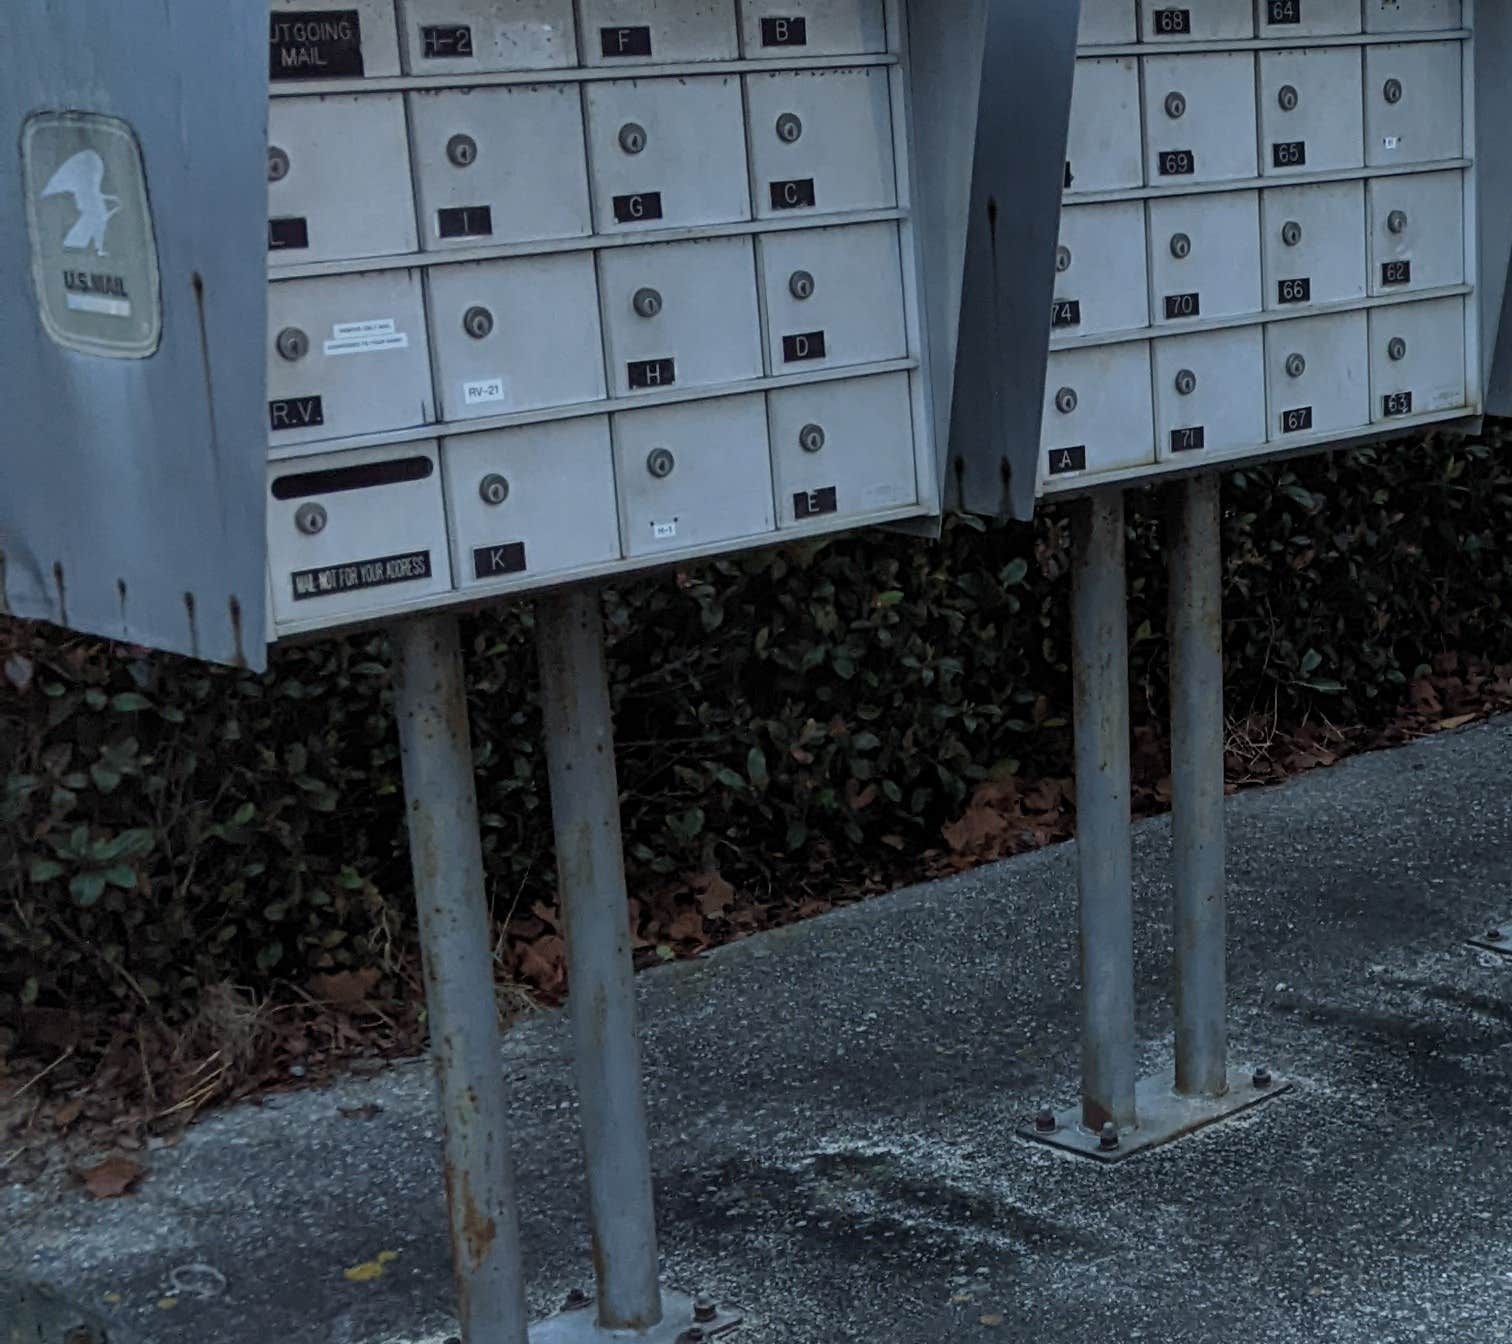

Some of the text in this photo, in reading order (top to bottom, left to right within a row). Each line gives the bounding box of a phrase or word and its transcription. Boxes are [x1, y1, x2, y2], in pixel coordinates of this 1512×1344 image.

[1161, 12, 1183, 31] 68
[1273, 2, 1293, 21] 64
[270, 22, 351, 42] UTGOING
[618, 30, 631, 52] F
[775, 20, 789, 42] B
[280, 46, 328, 68] MAIL
[1166, 154, 1188, 173] 69
[1278, 144, 1299, 163] 65
[784, 183, 797, 203] C
[629, 196, 643, 217] G
[1387, 263, 1405, 280] 62
[1283, 280, 1304, 300] 66
[1051, 303, 1071, 323] 74
[1171, 296, 1193, 314] 70
[796, 337, 808, 356] D
[646, 364, 661, 384] H
[468, 385, 499, 398] RV-21
[271, 401, 322, 425] R.V.
[1388, 394, 1407, 413] 63
[1288, 410, 1306, 429] 67
[1180, 430, 1194, 448] 71
[1059, 450, 1072, 468] A
[807, 490, 820, 513] E
[490, 549, 504, 570] K
[296, 556, 425, 593] MAIL NOT FOR YOUR ADDRESS
